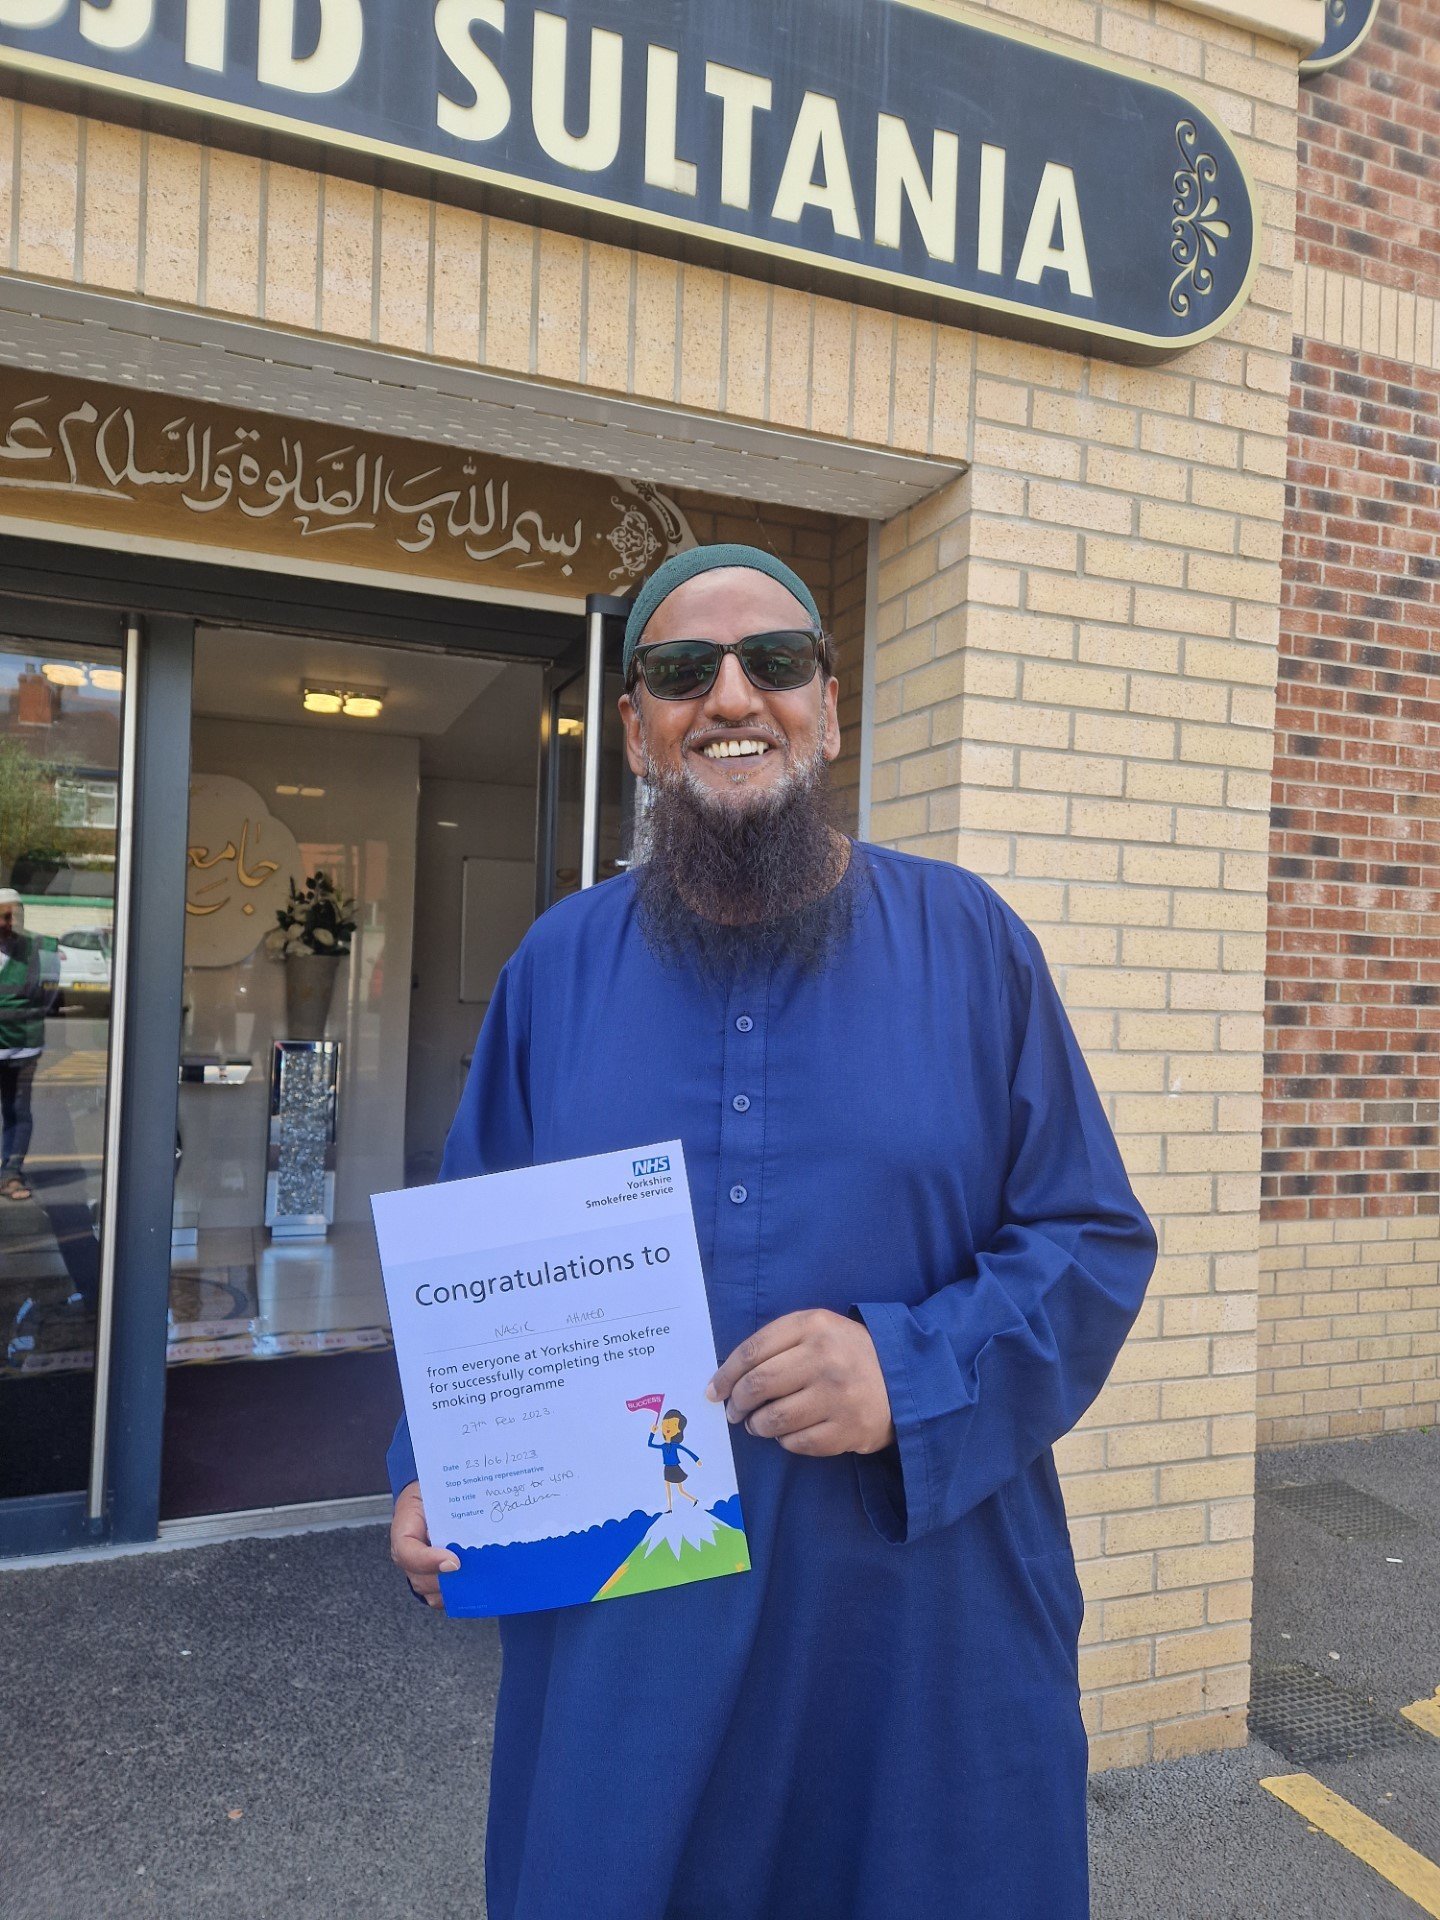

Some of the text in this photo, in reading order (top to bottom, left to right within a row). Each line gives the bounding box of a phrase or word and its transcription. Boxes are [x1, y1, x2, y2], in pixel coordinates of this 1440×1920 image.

[434, 0, 1093, 298] SULTANIA
[634, 1156, 670, 1177] NHS
[627, 1175, 672, 1190] Yorkshire
[585, 1186, 674, 1208] Smokefree service
[415, 1245, 671, 1306] Congratulations to
[427, 1325, 670, 1378] from everyone at Yorkshire Smokefree
[429, 1343, 656, 1394] for successfully completing the stop
[432, 1378, 565, 1410] smoking programme
[627, 1395, 662, 1409] SUCCESS
[443, 1464, 460, 1473] Date
[445, 1465, 545, 1488] Stop Smoking representative
[448, 1493, 477, 1504] Job title
[450, 1508, 485, 1519] Signature
